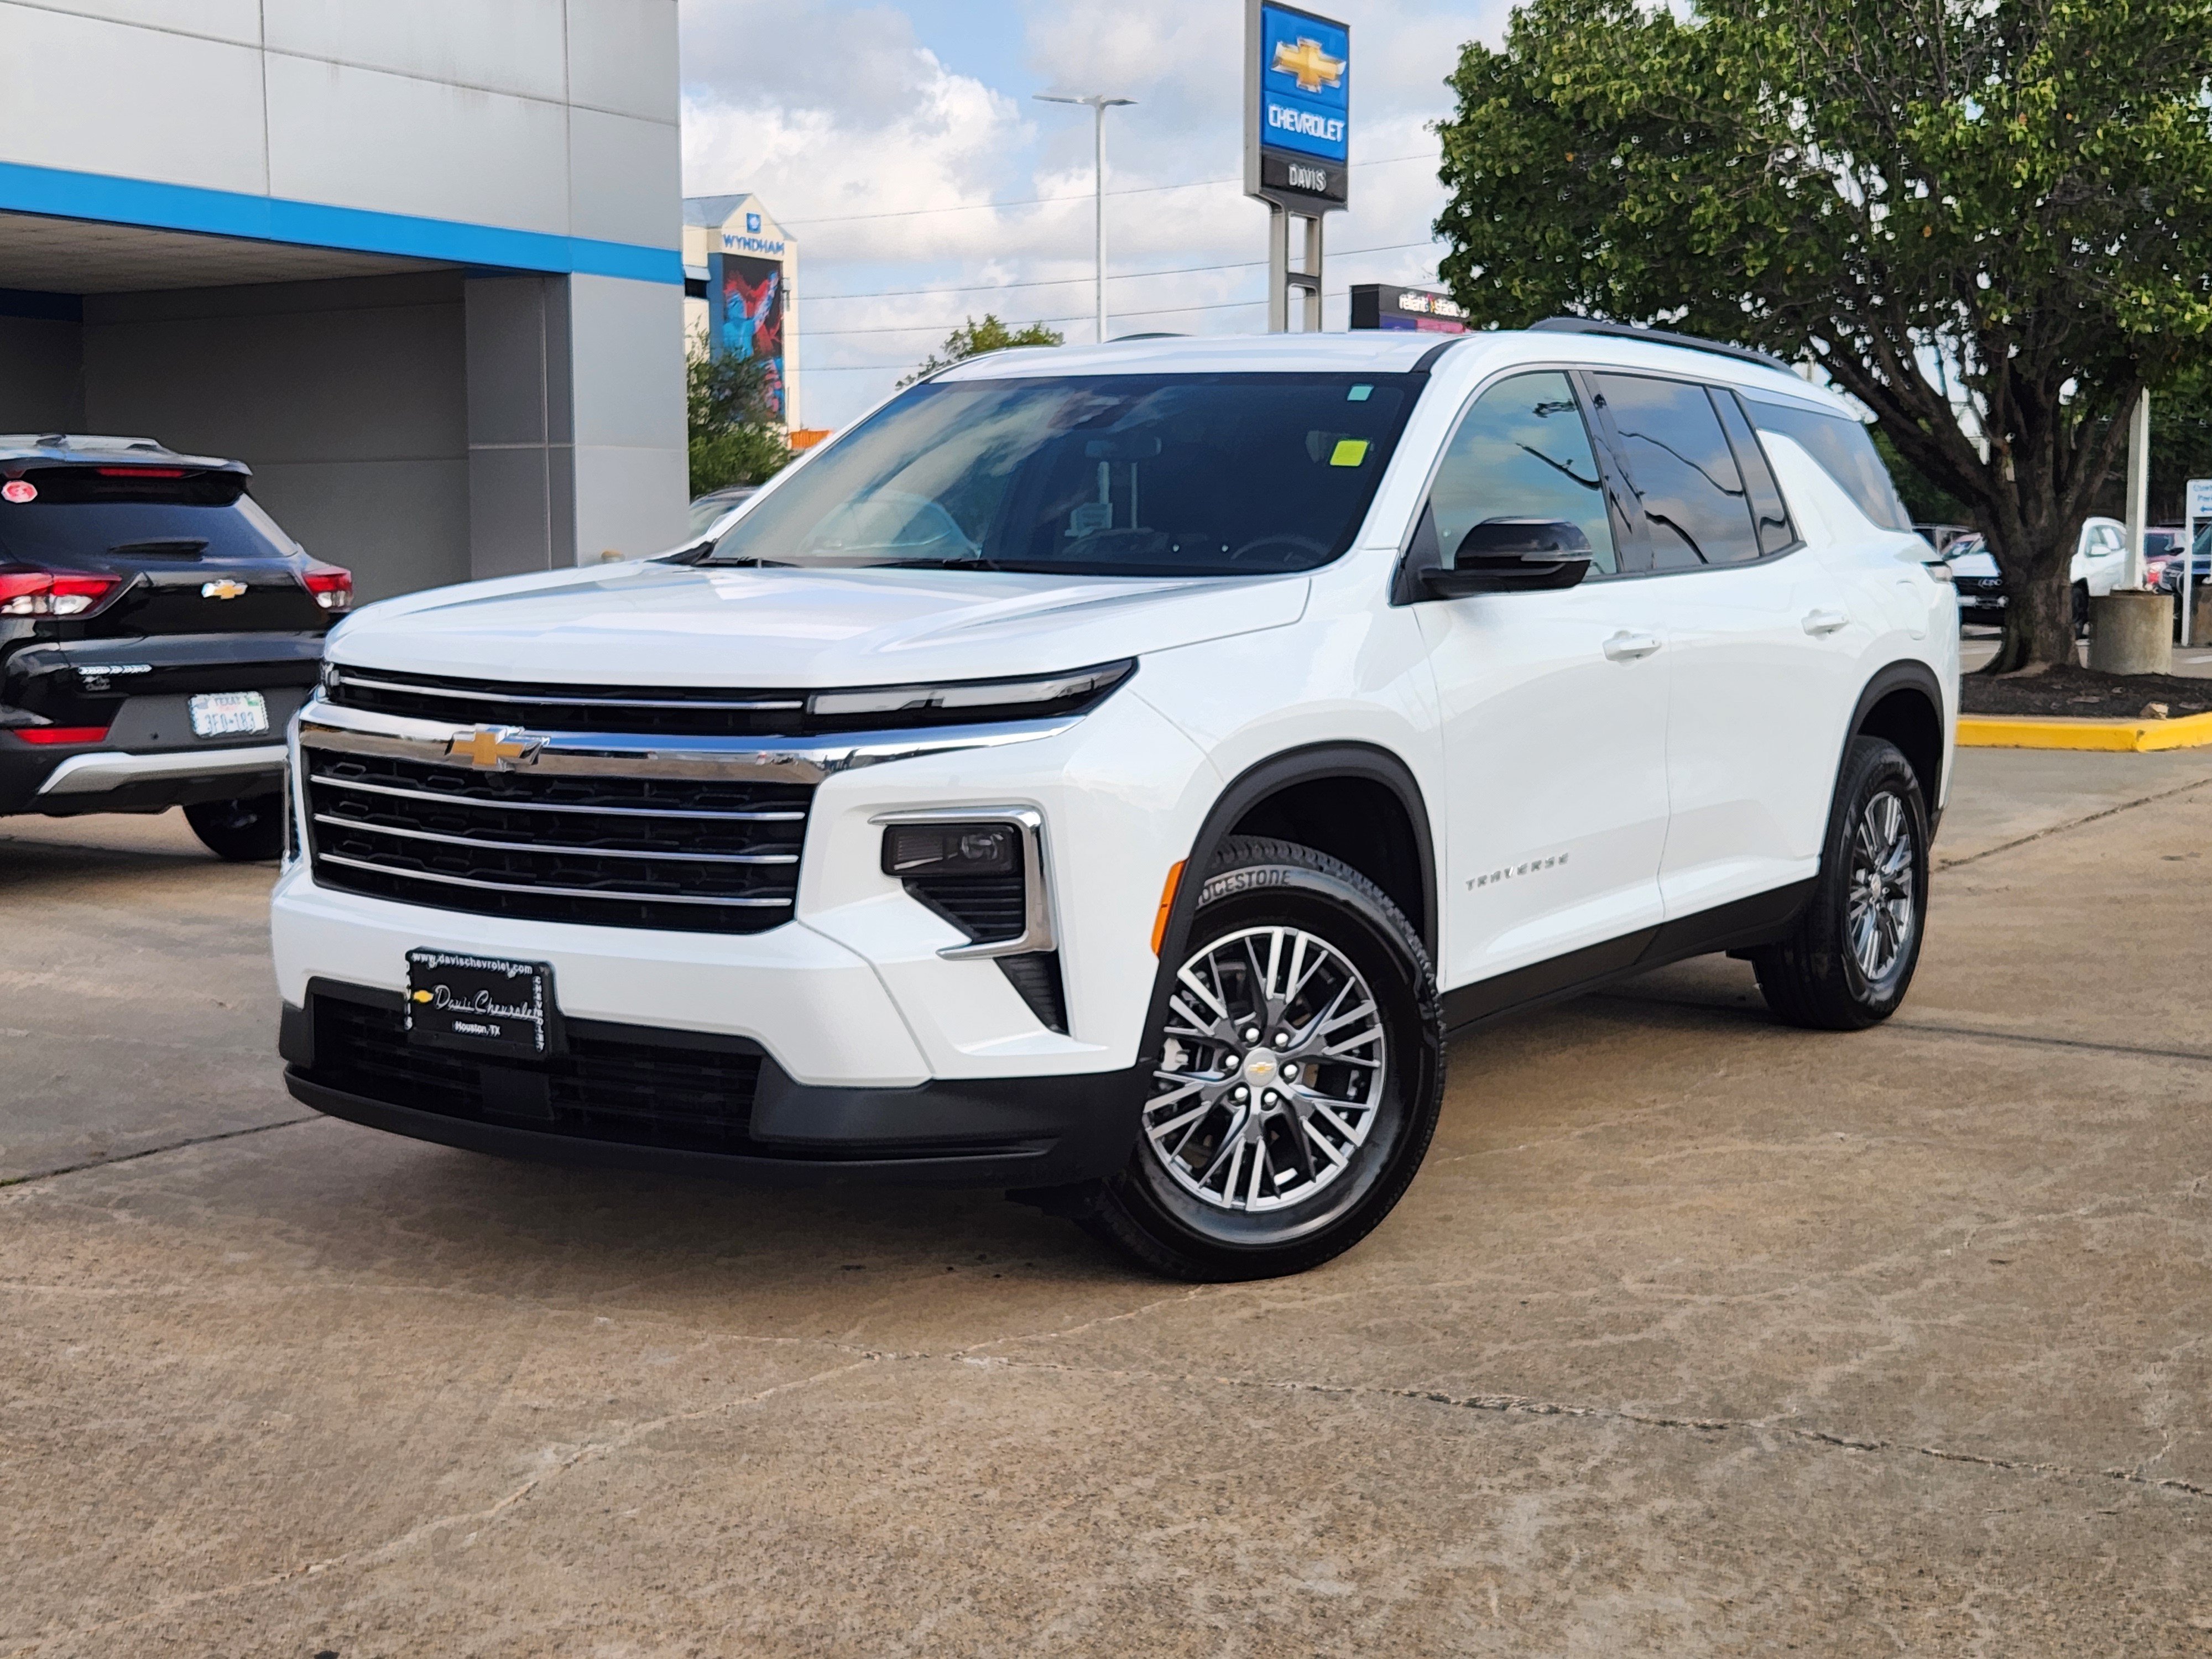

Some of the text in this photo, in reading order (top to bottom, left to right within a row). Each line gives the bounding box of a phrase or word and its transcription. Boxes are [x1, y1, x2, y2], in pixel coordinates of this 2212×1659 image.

[1268, 103, 1345, 143] CHEVROLET
[1288, 164, 1327, 192] DAVIS
[723, 234, 785, 255] WYNDHAM
[1465, 852, 1569, 891] TRAVERSE
[412, 952, 533, 975] www.davischevrolet.com
[474, 990, 540, 1020] Chevrolet
[453, 1021, 501, 1037] Houston, TX
